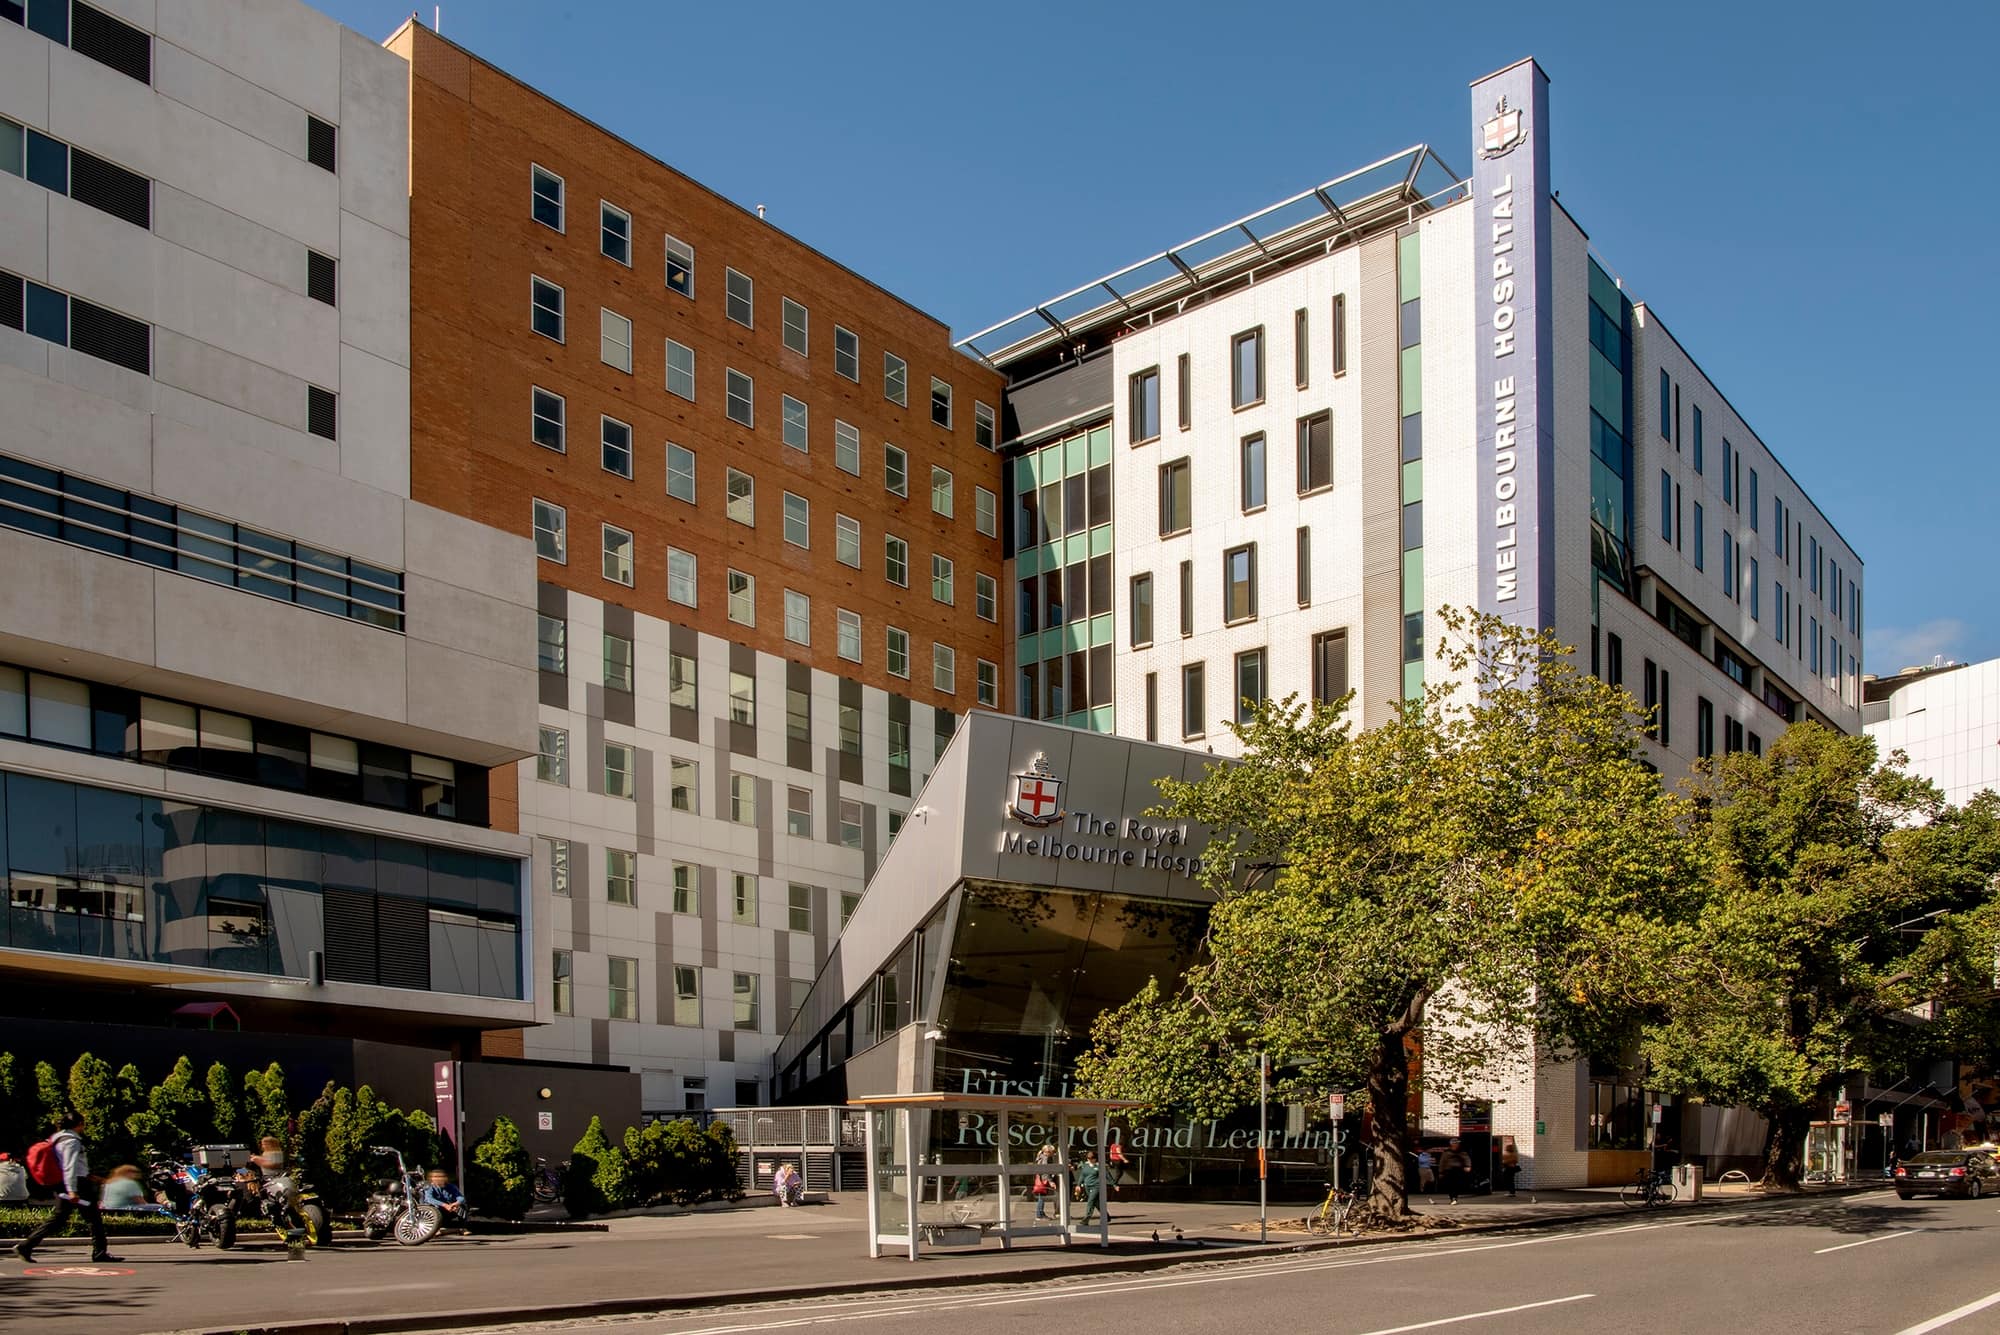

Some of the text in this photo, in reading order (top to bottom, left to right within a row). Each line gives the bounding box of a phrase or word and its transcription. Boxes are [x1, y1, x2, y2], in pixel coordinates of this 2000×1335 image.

[1493, 174, 1515, 358] HOSPITAL
[1495, 375, 1517, 602] MELBOURNE
[1073, 811, 1188, 848] The Royal
[998, 831, 1135, 867] Melbourne
[961, 1067, 1050, 1097] First
[1131, 1118, 1195, 1149] and
[1206, 1120, 1349, 1157] Learning
